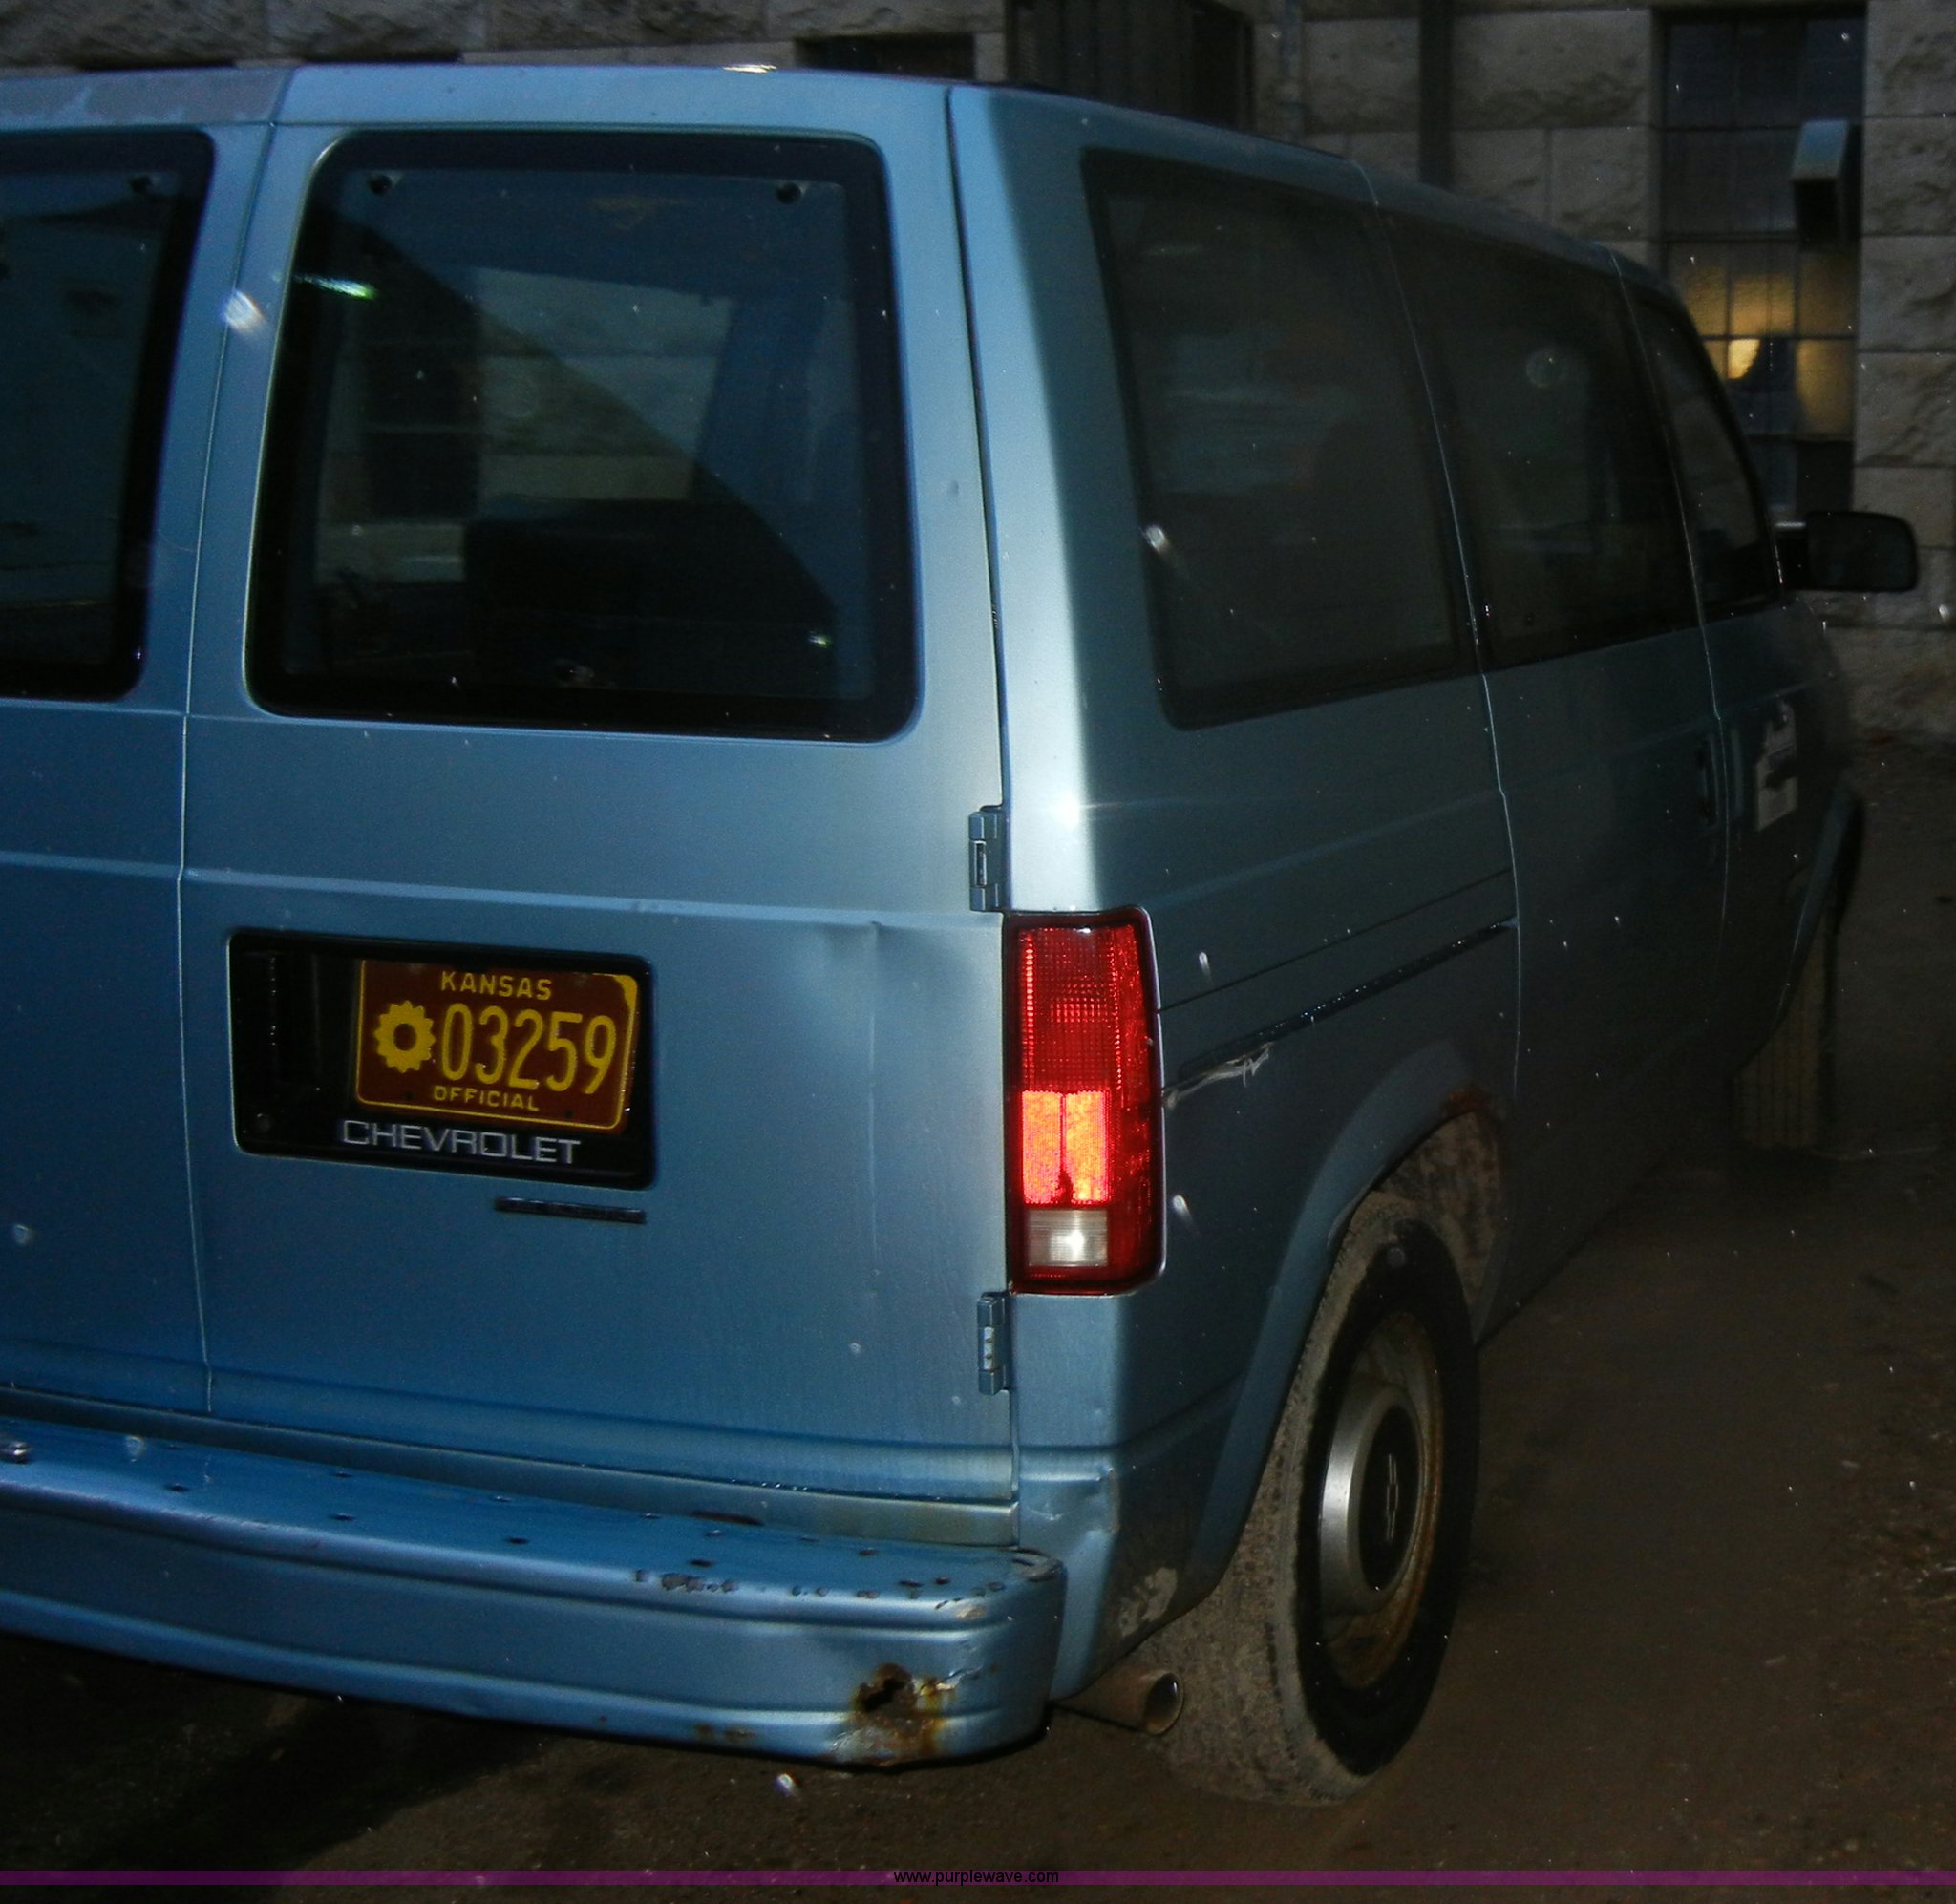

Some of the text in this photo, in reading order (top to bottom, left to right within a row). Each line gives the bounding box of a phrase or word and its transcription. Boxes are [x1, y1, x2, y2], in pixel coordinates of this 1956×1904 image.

[441, 971, 552, 1000] KANSAS
[442, 1004, 616, 1094] 03259
[434, 1086, 540, 1111] OFFICIAL
[342, 1120, 581, 1164] CHEVROLET
